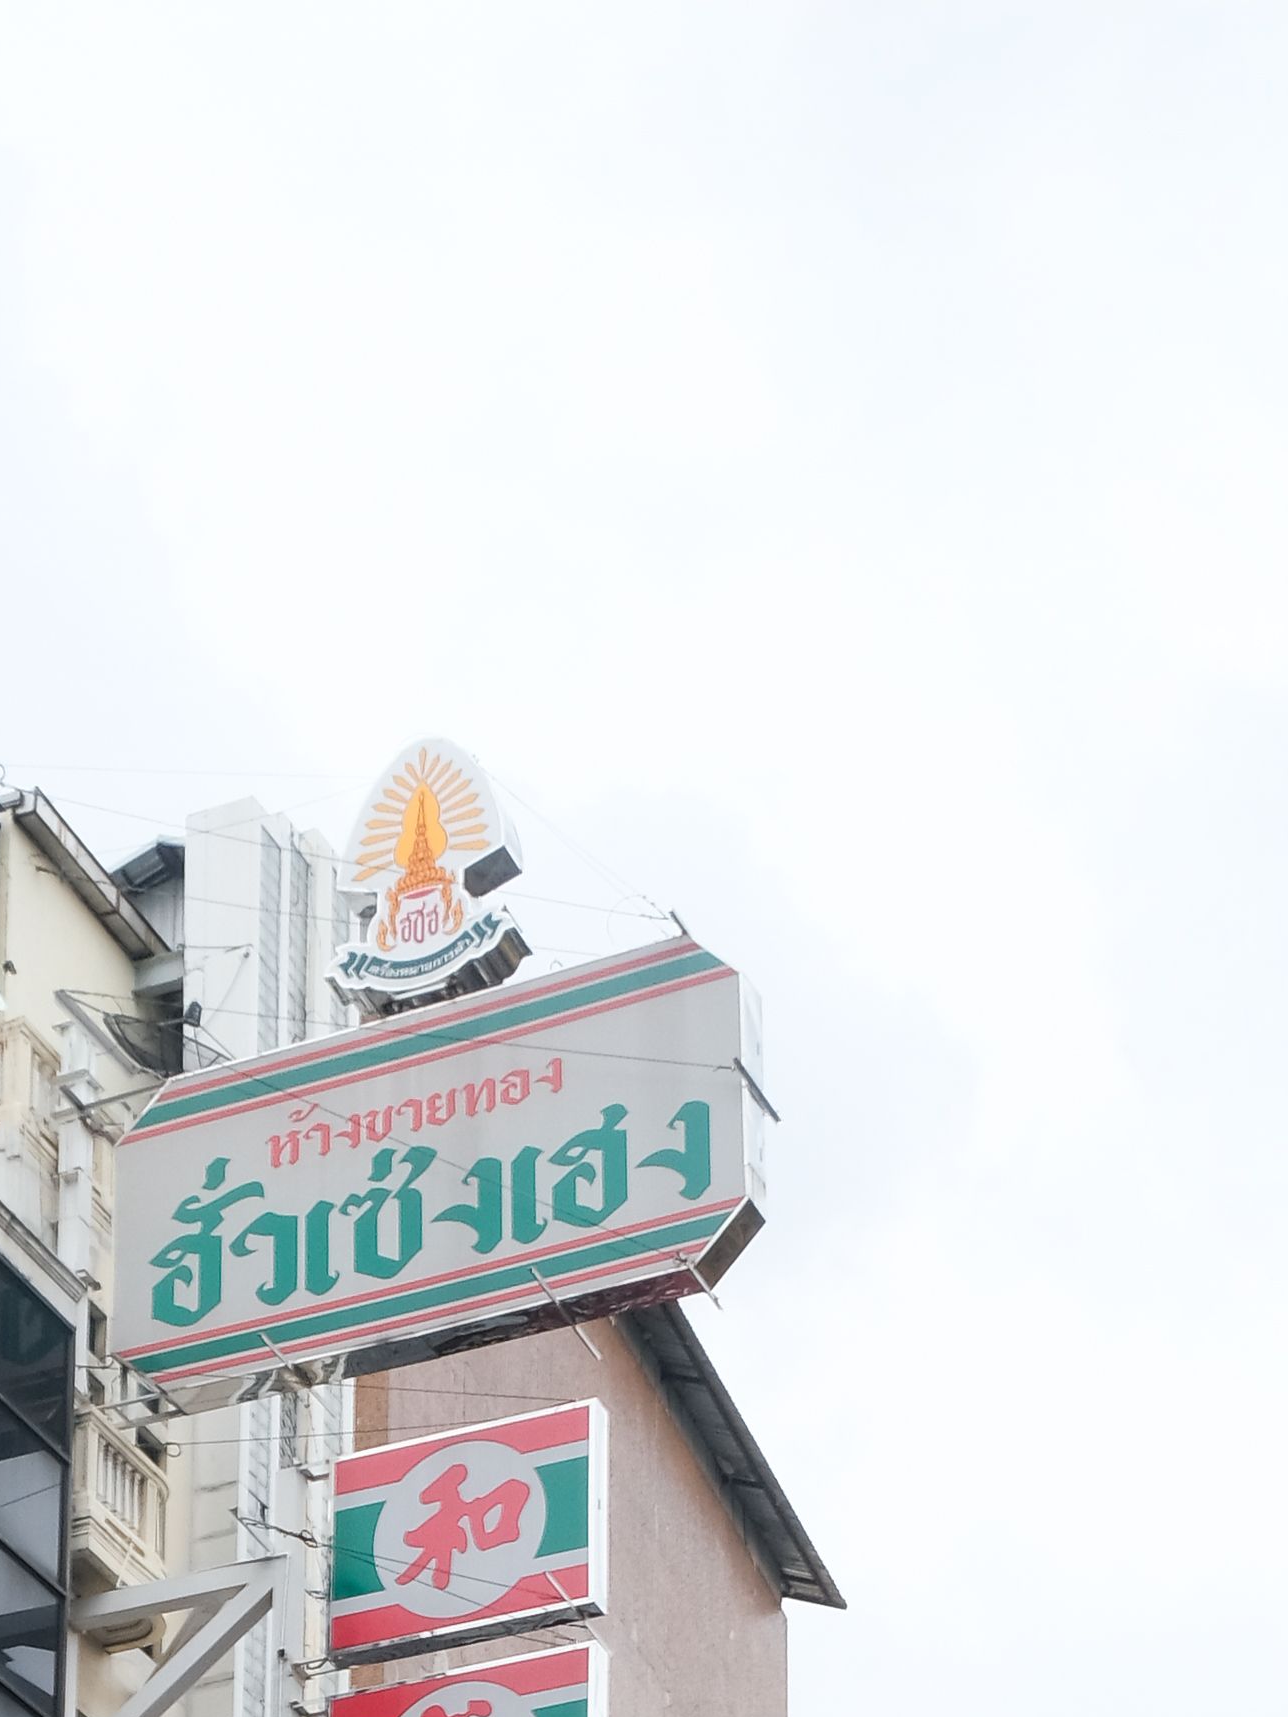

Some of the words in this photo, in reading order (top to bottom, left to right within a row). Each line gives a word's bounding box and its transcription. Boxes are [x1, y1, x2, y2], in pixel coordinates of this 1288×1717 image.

[267, 1056, 566, 1169] ห้างขายทอง
[150, 1099, 713, 1327] ฮั่วเซ่งเฮง
